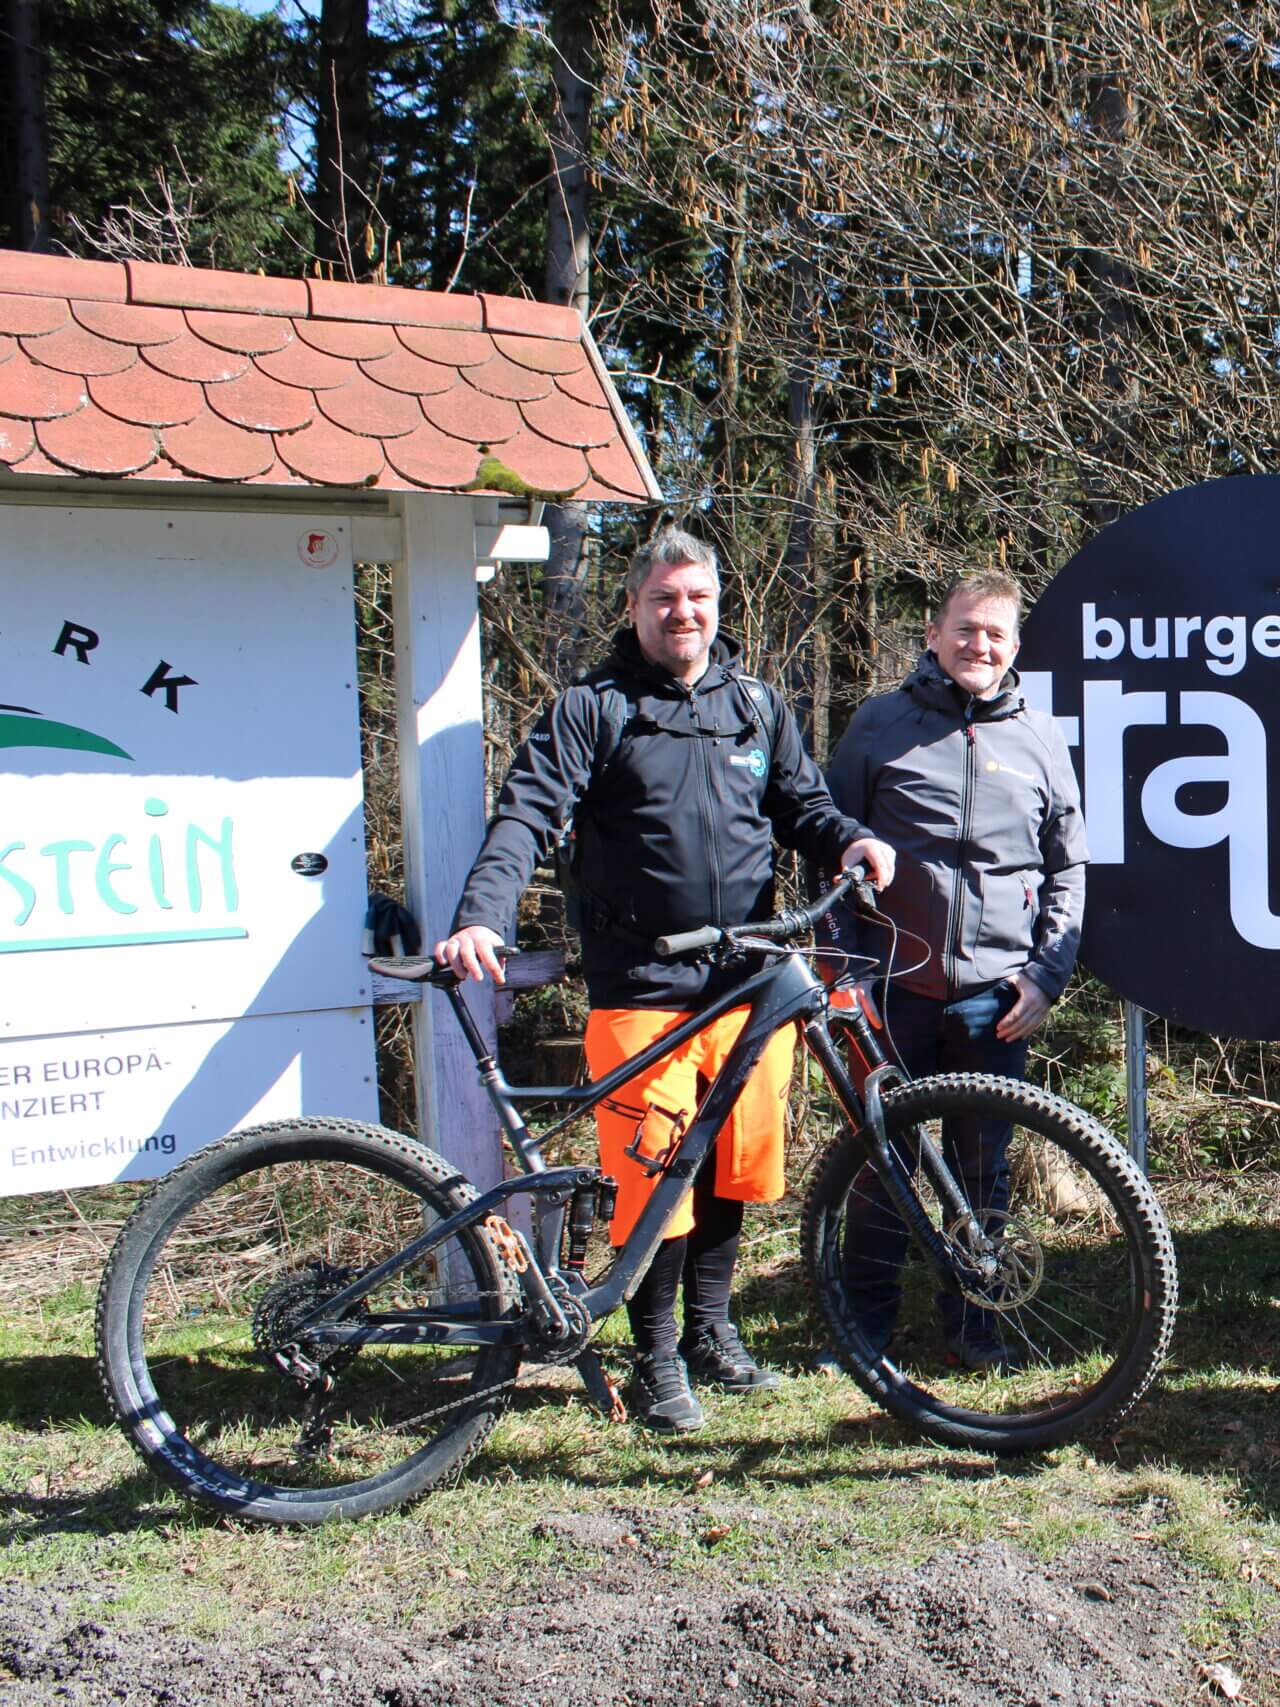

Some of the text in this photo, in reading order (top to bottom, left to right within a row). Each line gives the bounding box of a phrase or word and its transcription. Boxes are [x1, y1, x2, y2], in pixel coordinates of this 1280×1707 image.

[43, 1047, 172, 1083] EUROPÄ-
[1, 1090, 105, 1121] NZIERT
[11, 1133, 176, 1167] Entwicklung
